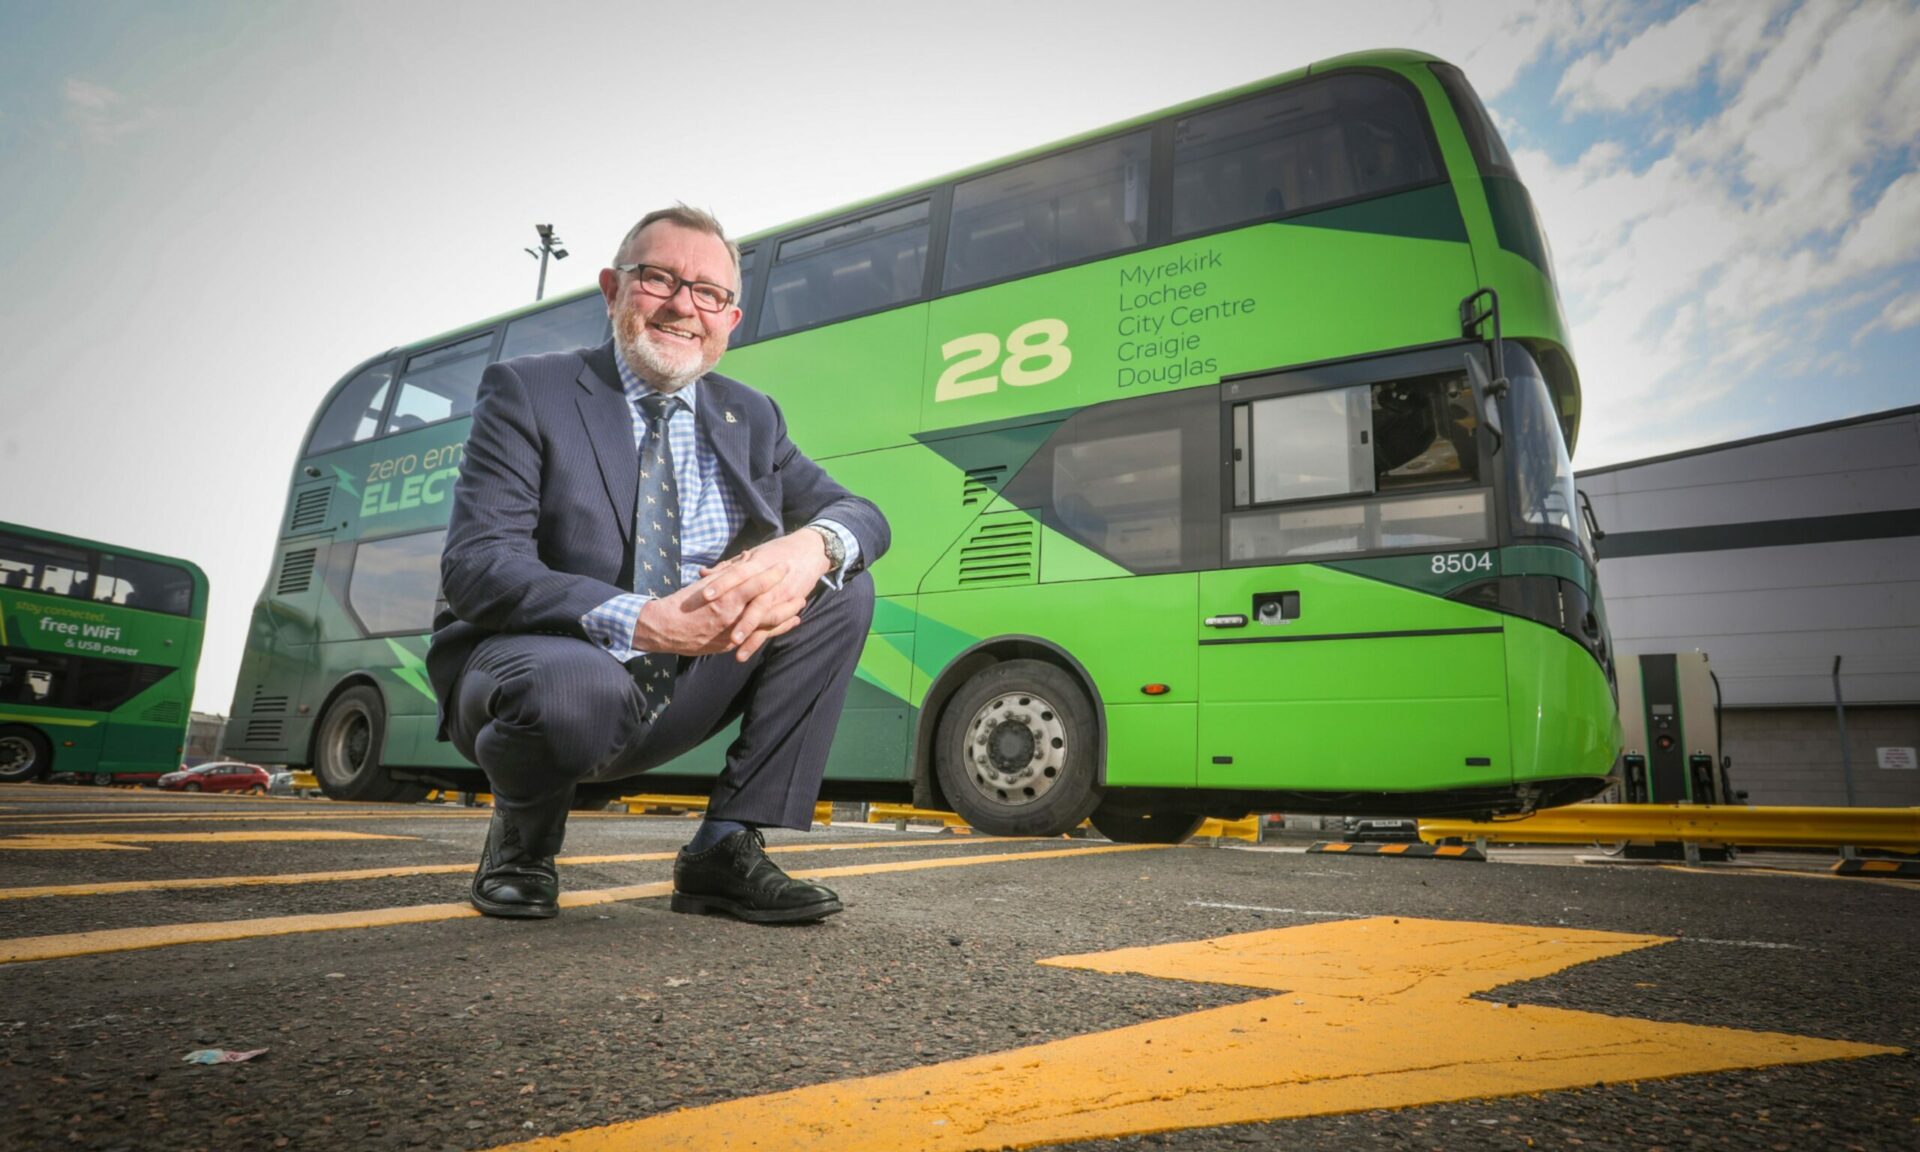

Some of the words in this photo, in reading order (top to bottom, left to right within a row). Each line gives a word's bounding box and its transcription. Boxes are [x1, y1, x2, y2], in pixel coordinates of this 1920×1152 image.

[1120, 249, 1223, 287] Myrekirk
[1120, 280, 1207, 312] Lochee
[1118, 314, 1165, 336] City
[1171, 297, 1256, 326] Centre
[935, 318, 1072, 402] 28
[1118, 332, 1201, 362] Craigie
[1118, 356, 1218, 388] Douglas
[366, 454, 417, 482] zero
[359, 466, 461, 518] ELEC
[1431, 552, 1493, 574] 8504
[16, 600, 41, 614] stay
[40, 616, 79, 635] free
[83, 623, 121, 641] WiFi
[64, 638, 76, 648] &
[78, 639, 101, 651] USB
[103, 644, 139, 656] power
